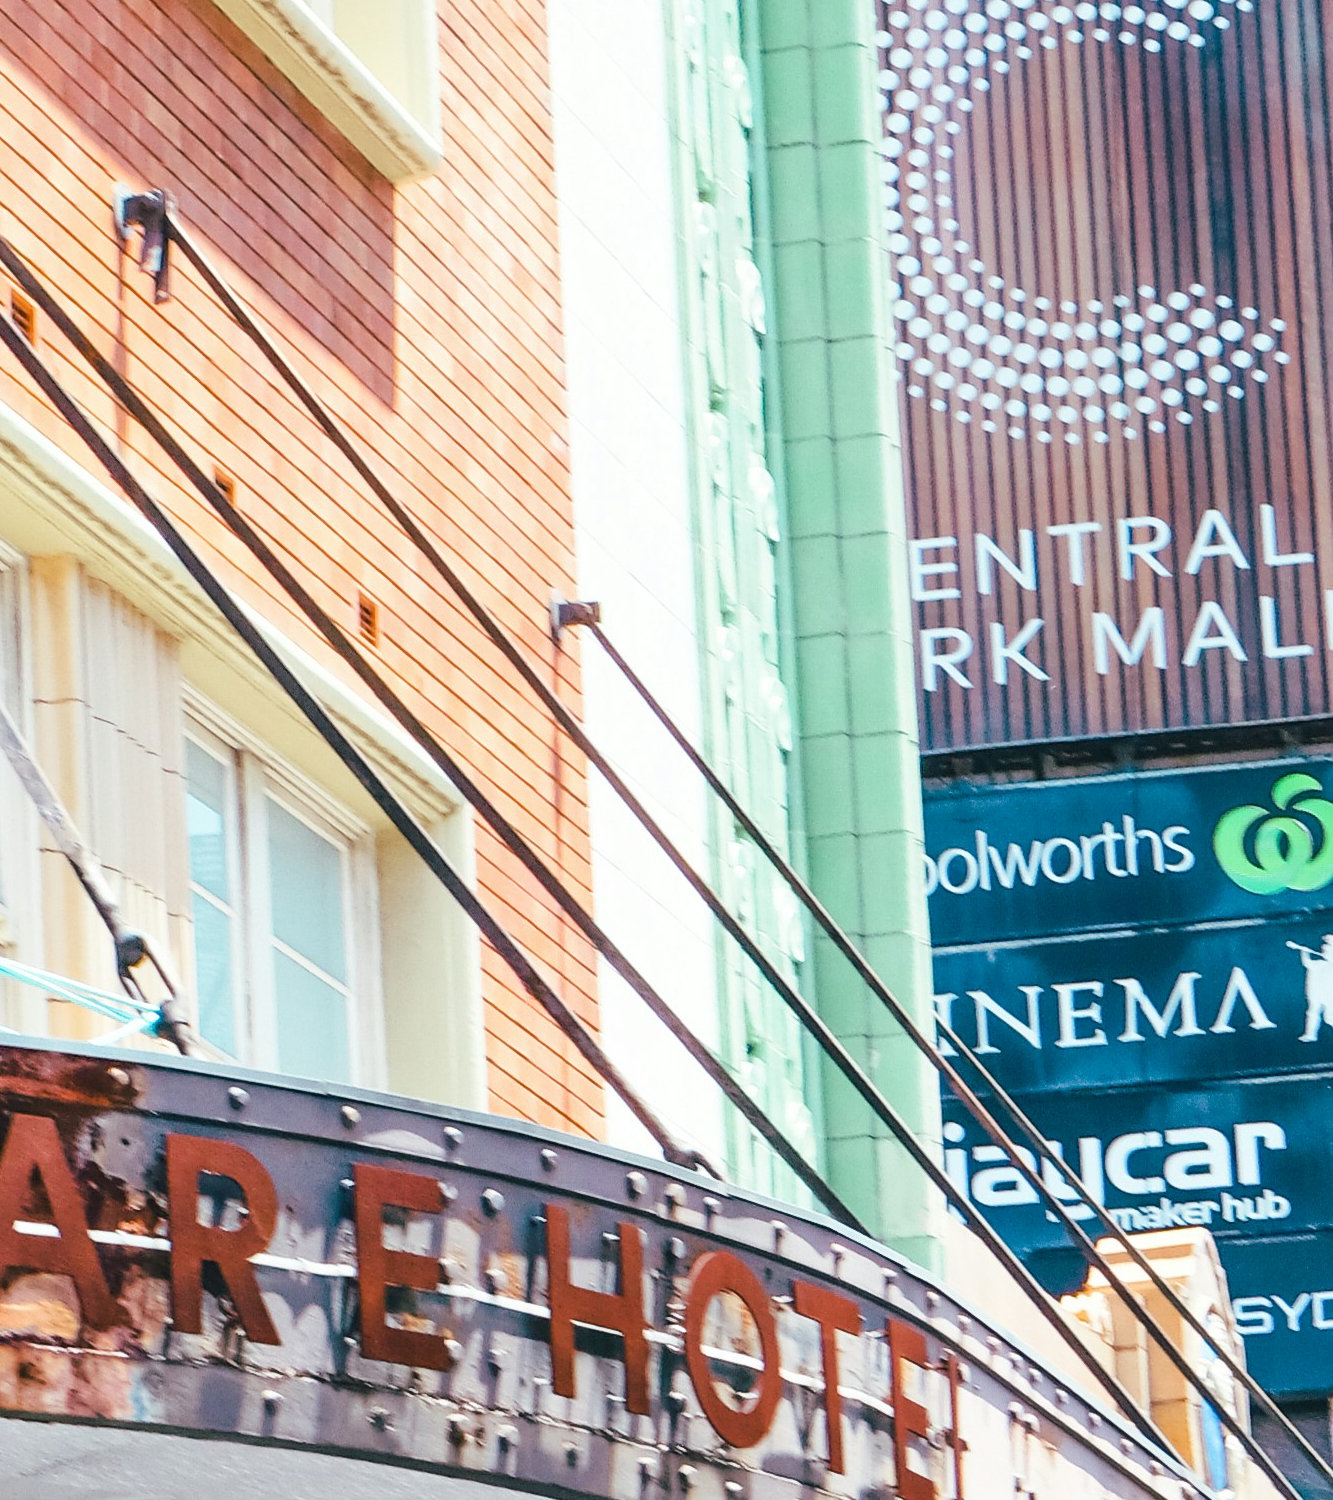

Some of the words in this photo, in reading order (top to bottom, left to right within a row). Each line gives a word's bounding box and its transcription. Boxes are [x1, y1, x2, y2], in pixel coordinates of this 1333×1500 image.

[908, 504, 1314, 601] ENTRAL
[920, 616, 1051, 692] RK
[1092, 589, 1333, 675] MAL
[943, 1121, 1288, 1225] jaycar
[1107, 1196, 1221, 1232] maker
[1221, 1188, 1292, 1224] hub
